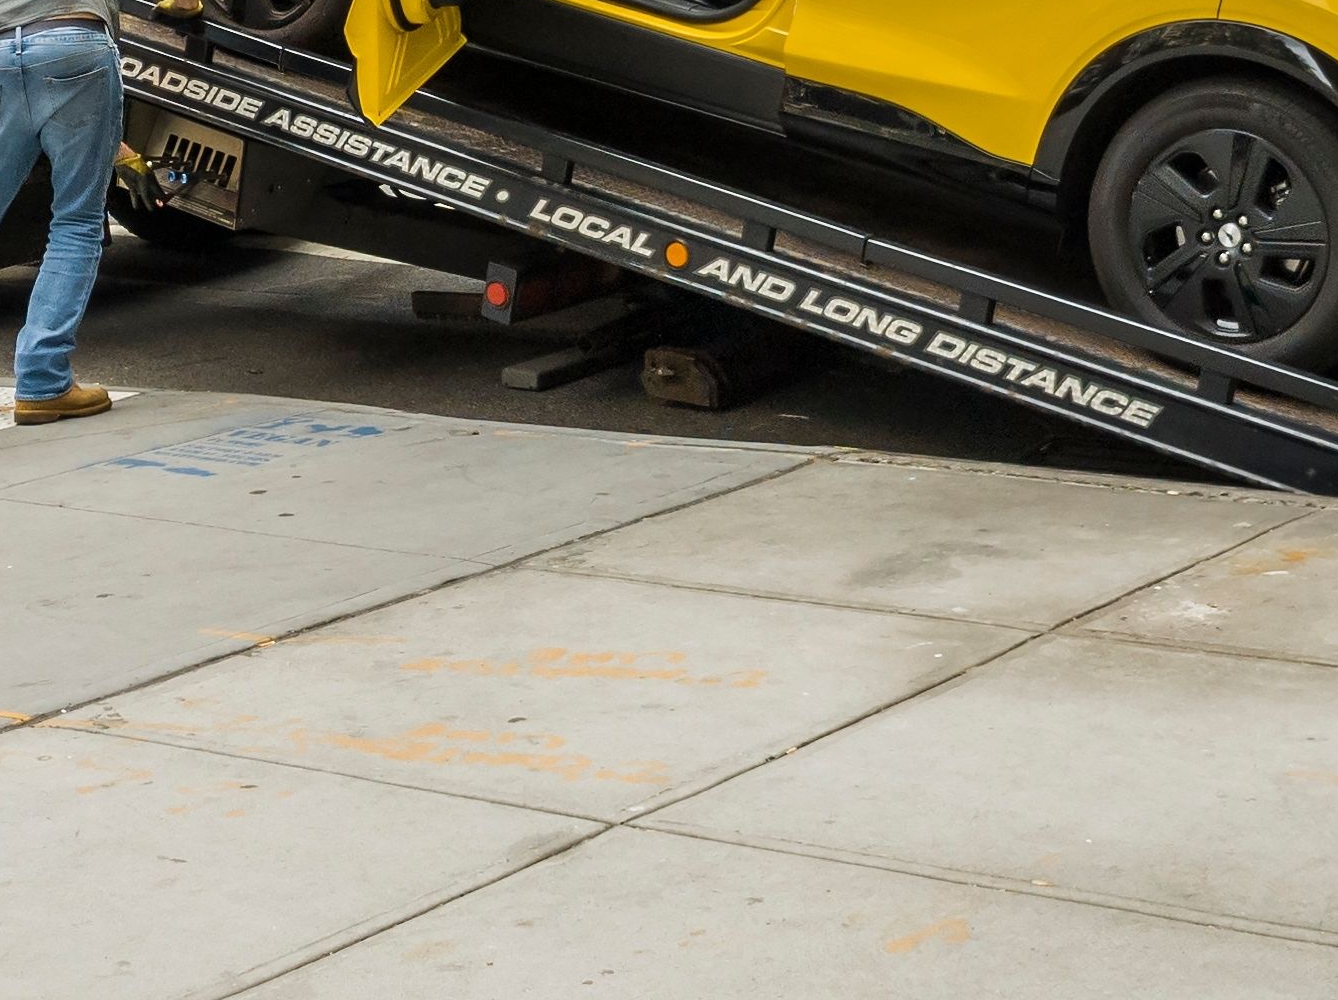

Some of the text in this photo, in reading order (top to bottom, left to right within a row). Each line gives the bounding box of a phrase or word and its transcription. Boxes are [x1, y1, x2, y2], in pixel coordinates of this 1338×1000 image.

[121, 55, 266, 120] OADSIDE
[264, 105, 493, 203] ASSISTANCE
[528, 197, 657, 258] LOCAL
[697, 256, 797, 302] AND
[798, 287, 925, 348] LONG
[926, 330, 1162, 430] DISTANCE
